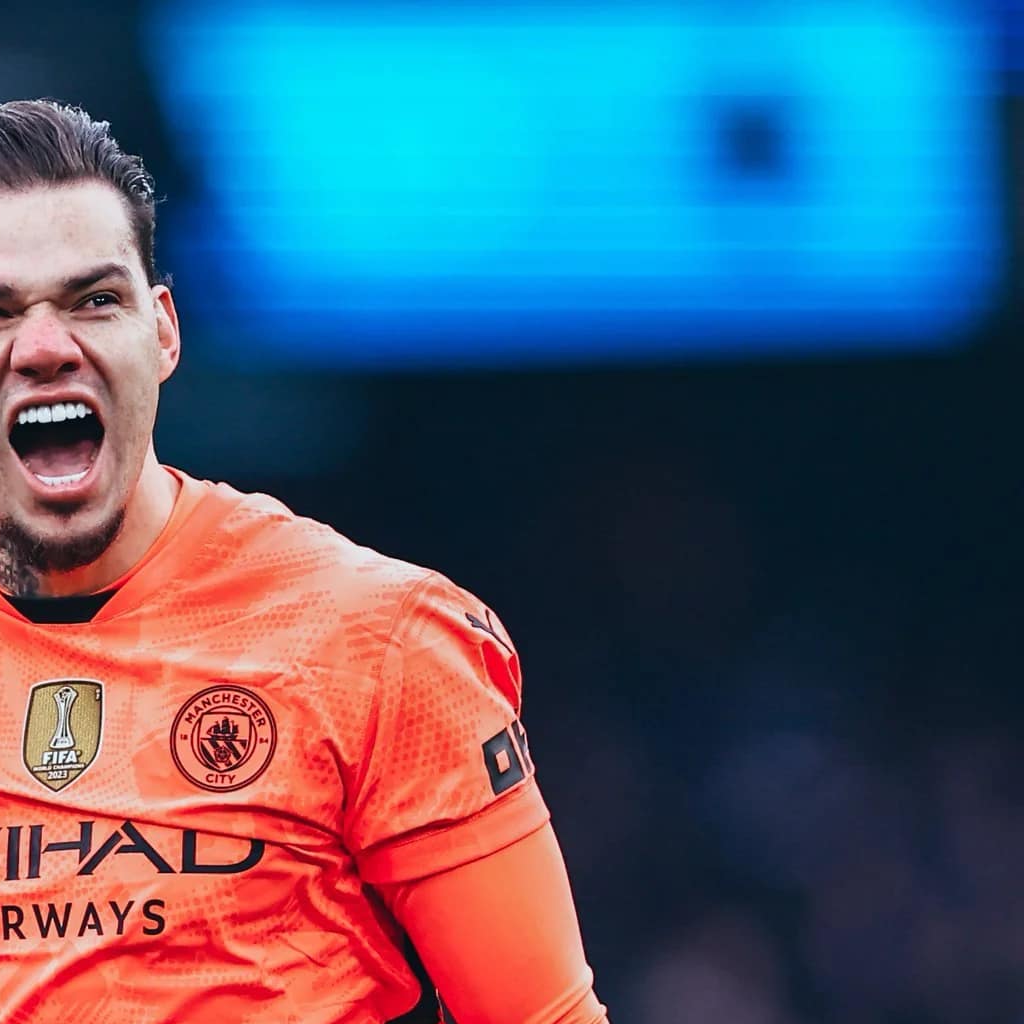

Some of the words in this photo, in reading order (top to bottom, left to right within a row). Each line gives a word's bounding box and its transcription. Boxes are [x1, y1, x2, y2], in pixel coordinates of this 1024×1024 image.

[184, 693, 266, 727] MANCHESTER
[42, 750, 78, 765] FIFA
[205, 773, 236, 784] CITY
